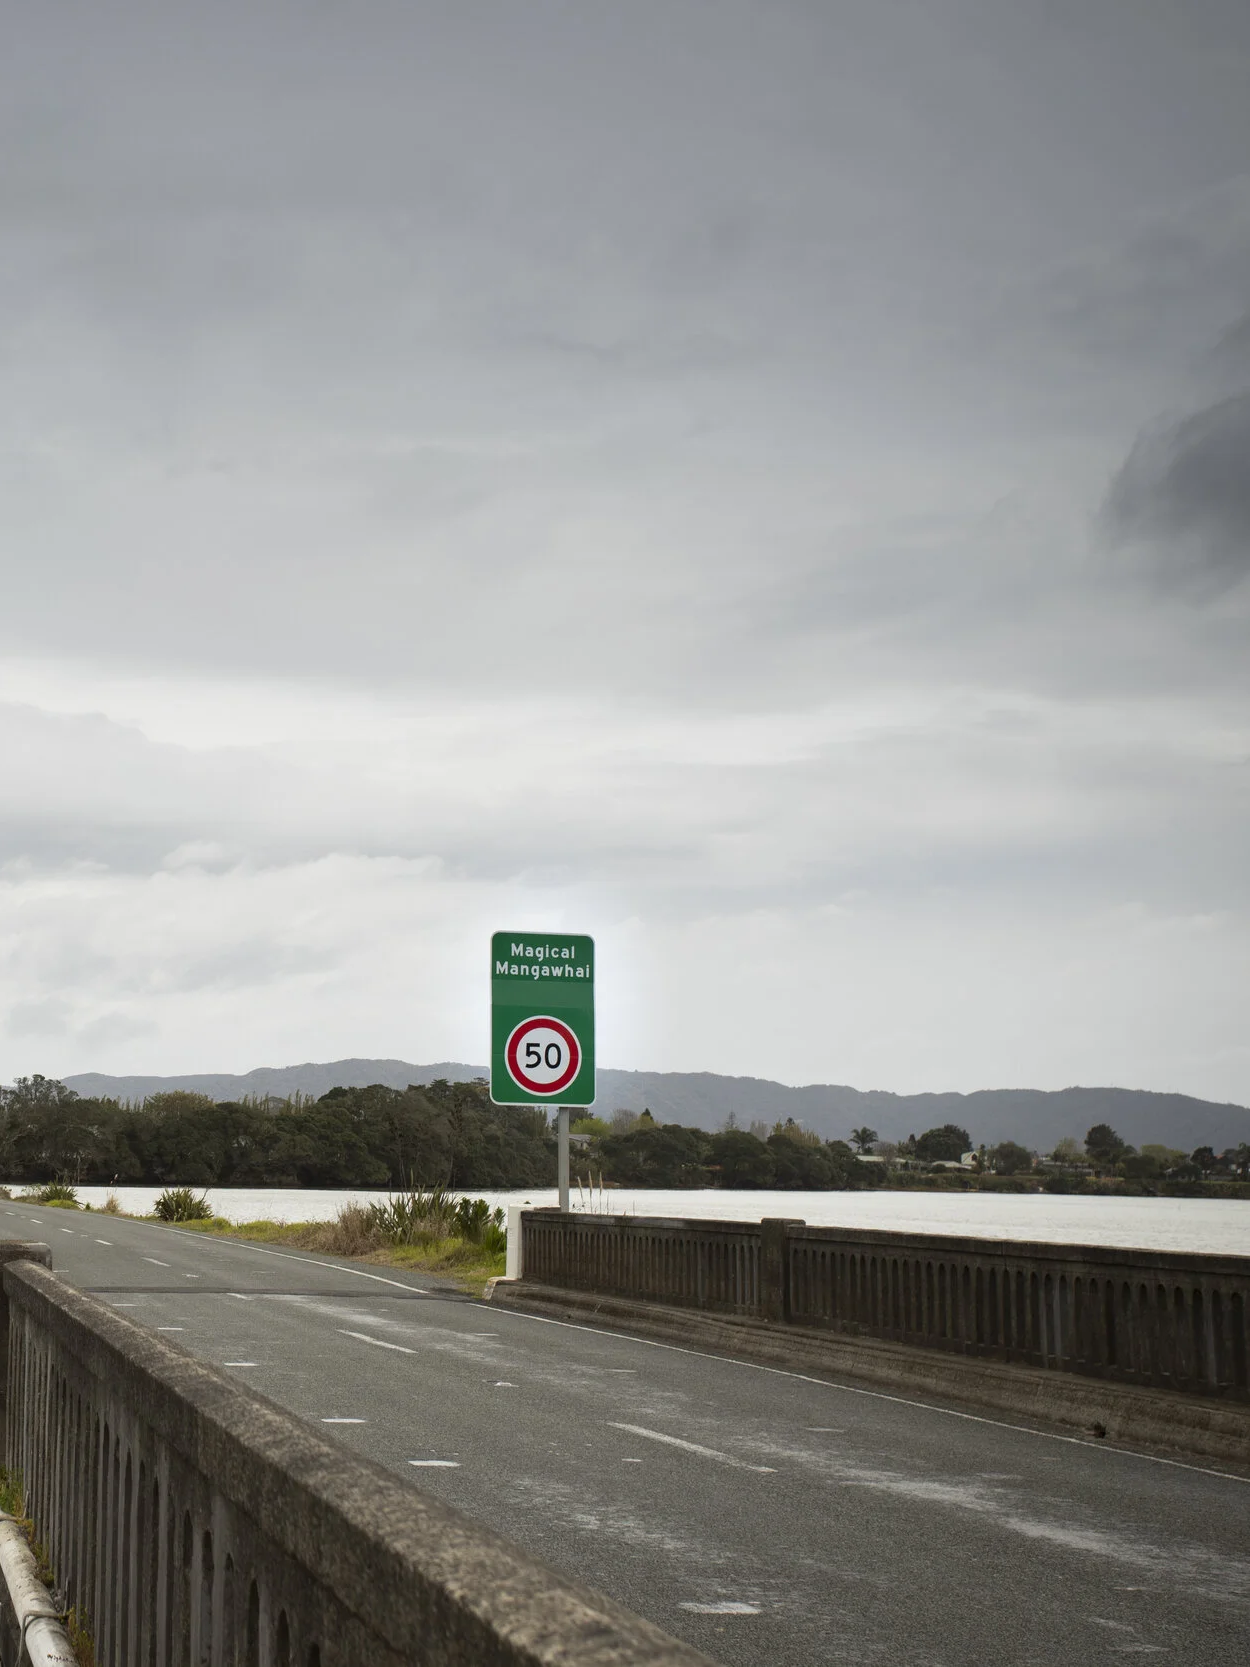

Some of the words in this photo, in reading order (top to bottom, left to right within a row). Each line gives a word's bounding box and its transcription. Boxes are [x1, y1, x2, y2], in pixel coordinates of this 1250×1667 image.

[511, 943, 575, 961] Magical
[495, 961, 590, 980] Mangawhai
[525, 1043, 562, 1069] 50
